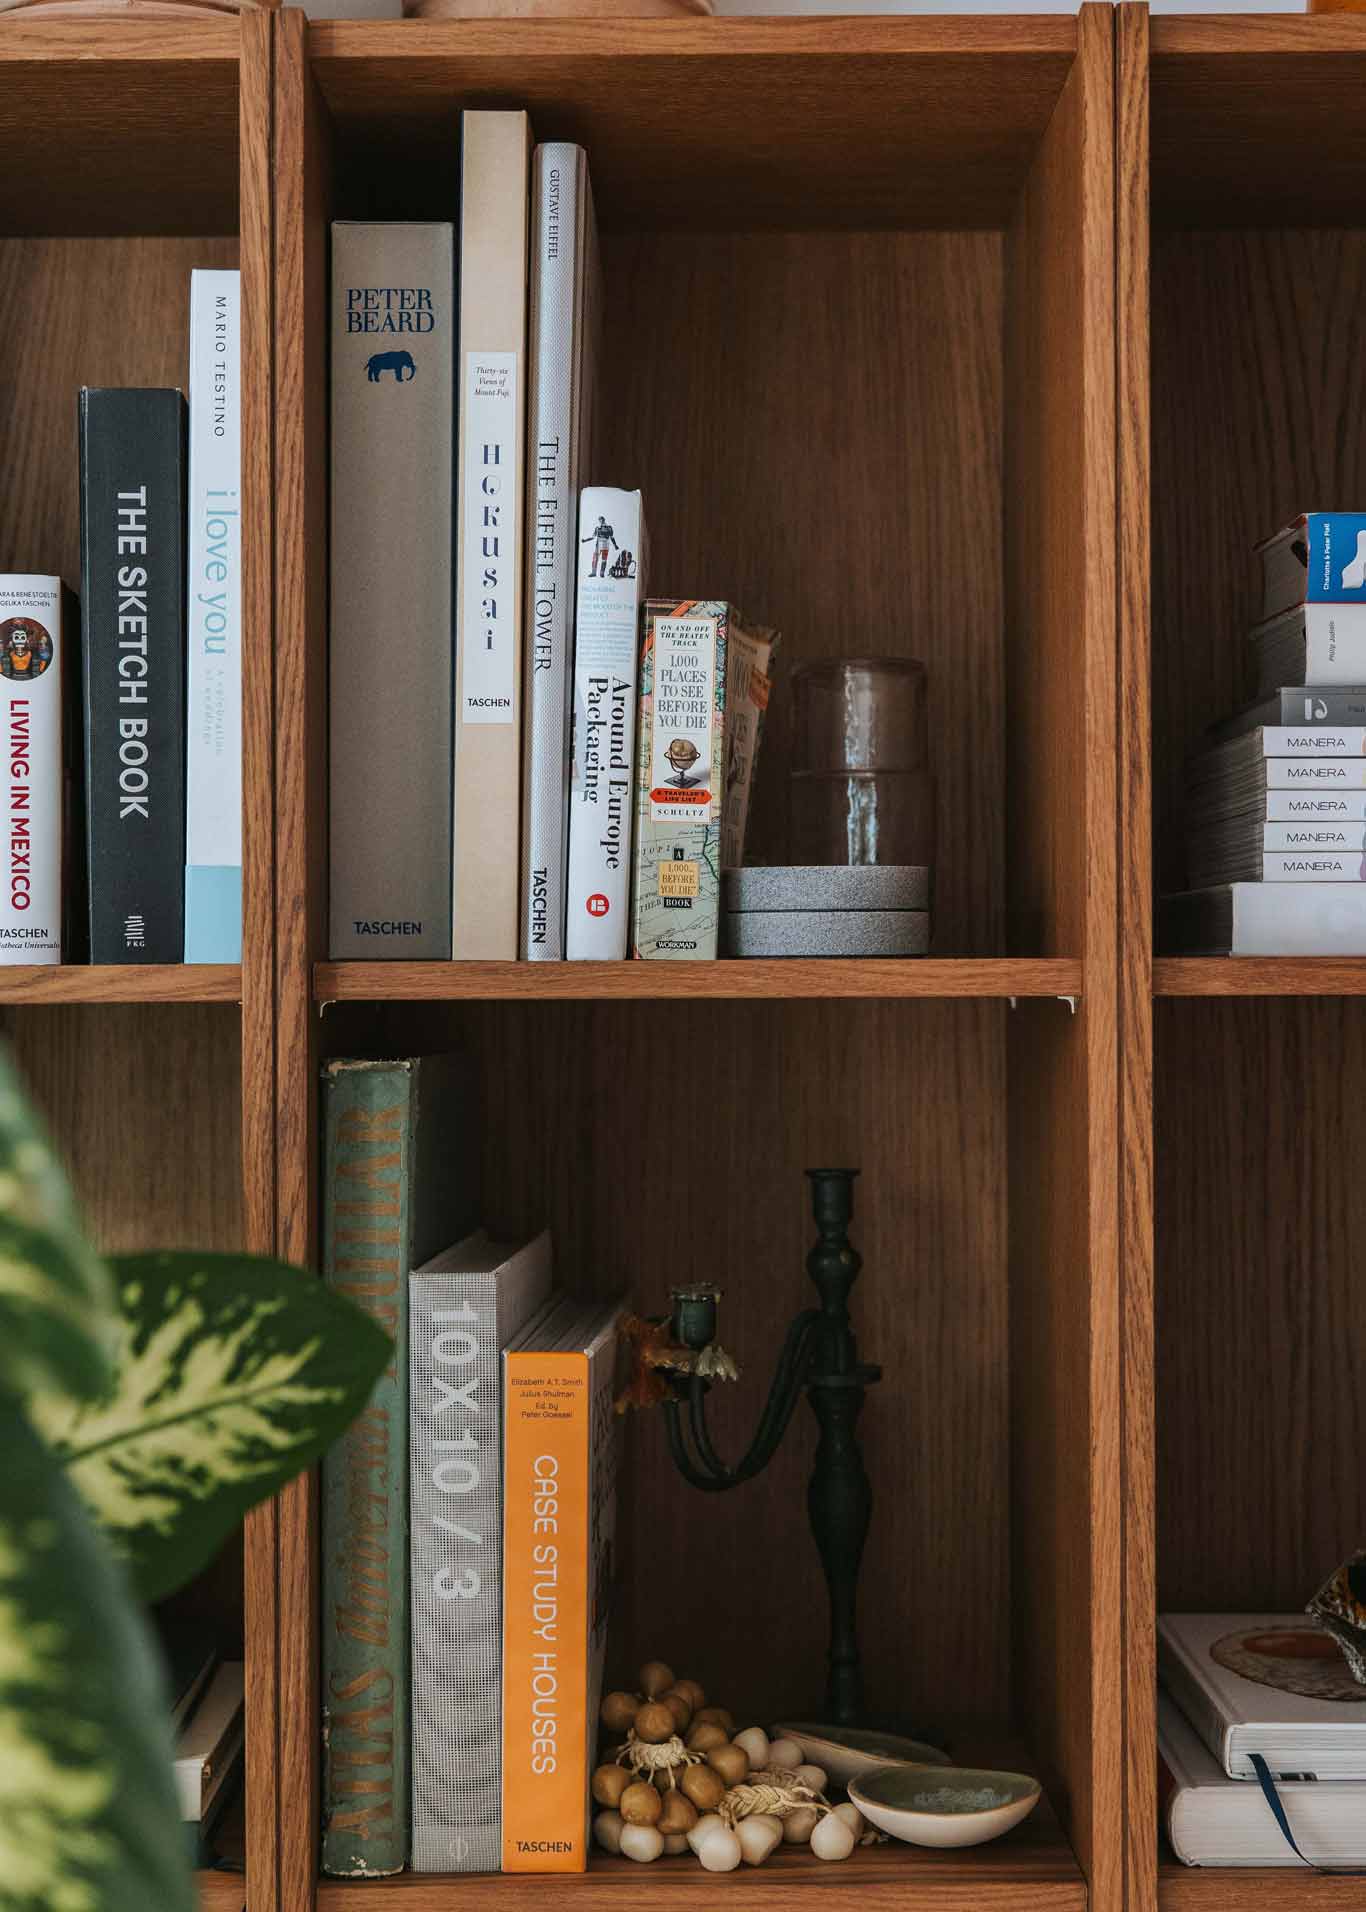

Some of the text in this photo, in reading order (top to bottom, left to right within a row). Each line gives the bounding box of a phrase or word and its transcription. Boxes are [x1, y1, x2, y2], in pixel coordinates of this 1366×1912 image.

[548, 169, 559, 260] GUSTAVE EIFFEL
[346, 288, 433, 311] PETER
[346, 311, 435, 334] BEARD
[214, 296, 226, 438] MARIO TESTINO
[535, 437, 559, 672] THE EIFFEL TOWER
[198, 487, 240, 656] i love you
[672, 639, 698, 647] TRACK
[117, 486, 150, 820] THE SKETCH BOOK
[670, 655, 698, 668] 1,000
[660, 669, 707, 682] PLACES
[661, 685, 704, 699] TO SEE
[467, 697, 510, 707] TASCHEN
[658, 700, 708, 714] BEFORE
[658, 715, 707, 729] YOU DIE
[583, 678, 609, 803] Packaging
[1287, 737, 1346, 748] MANERA
[600, 677, 633, 870] Around Europe
[1288, 768, 1347, 778] MANERA
[10, 699, 31, 912] LIVING IN MEXICO
[1288, 801, 1348, 812] MANERA
[656, 808, 704, 817] SCHULTZ
[1286, 832, 1346, 842] MANERA
[676, 850, 682, 859] A
[1282, 862, 1343, 872] MANERA
[662, 874, 695, 885] BEFORE
[661, 885, 677, 895] YOU
[532, 867, 548, 945] TASCHEN
[665, 899, 691, 907] BOOK
[0, 928, 49, 938] TASCHEN
[353, 921, 422, 936] TASCHEN
[658, 941, 696, 949] WORKMAN
[511, 1378, 545, 1386] Elizabeth
[562, 1378, 584, 1386] Smith
[543, 1390, 575, 1398] Shulman
[548, 1403, 559, 1411] by
[531, 1455, 559, 1775] CASE STUDY HOUSES
[328, 1667, 394, 1840] ATLAS
[516, 1840, 573, 1854] TASCHEN
